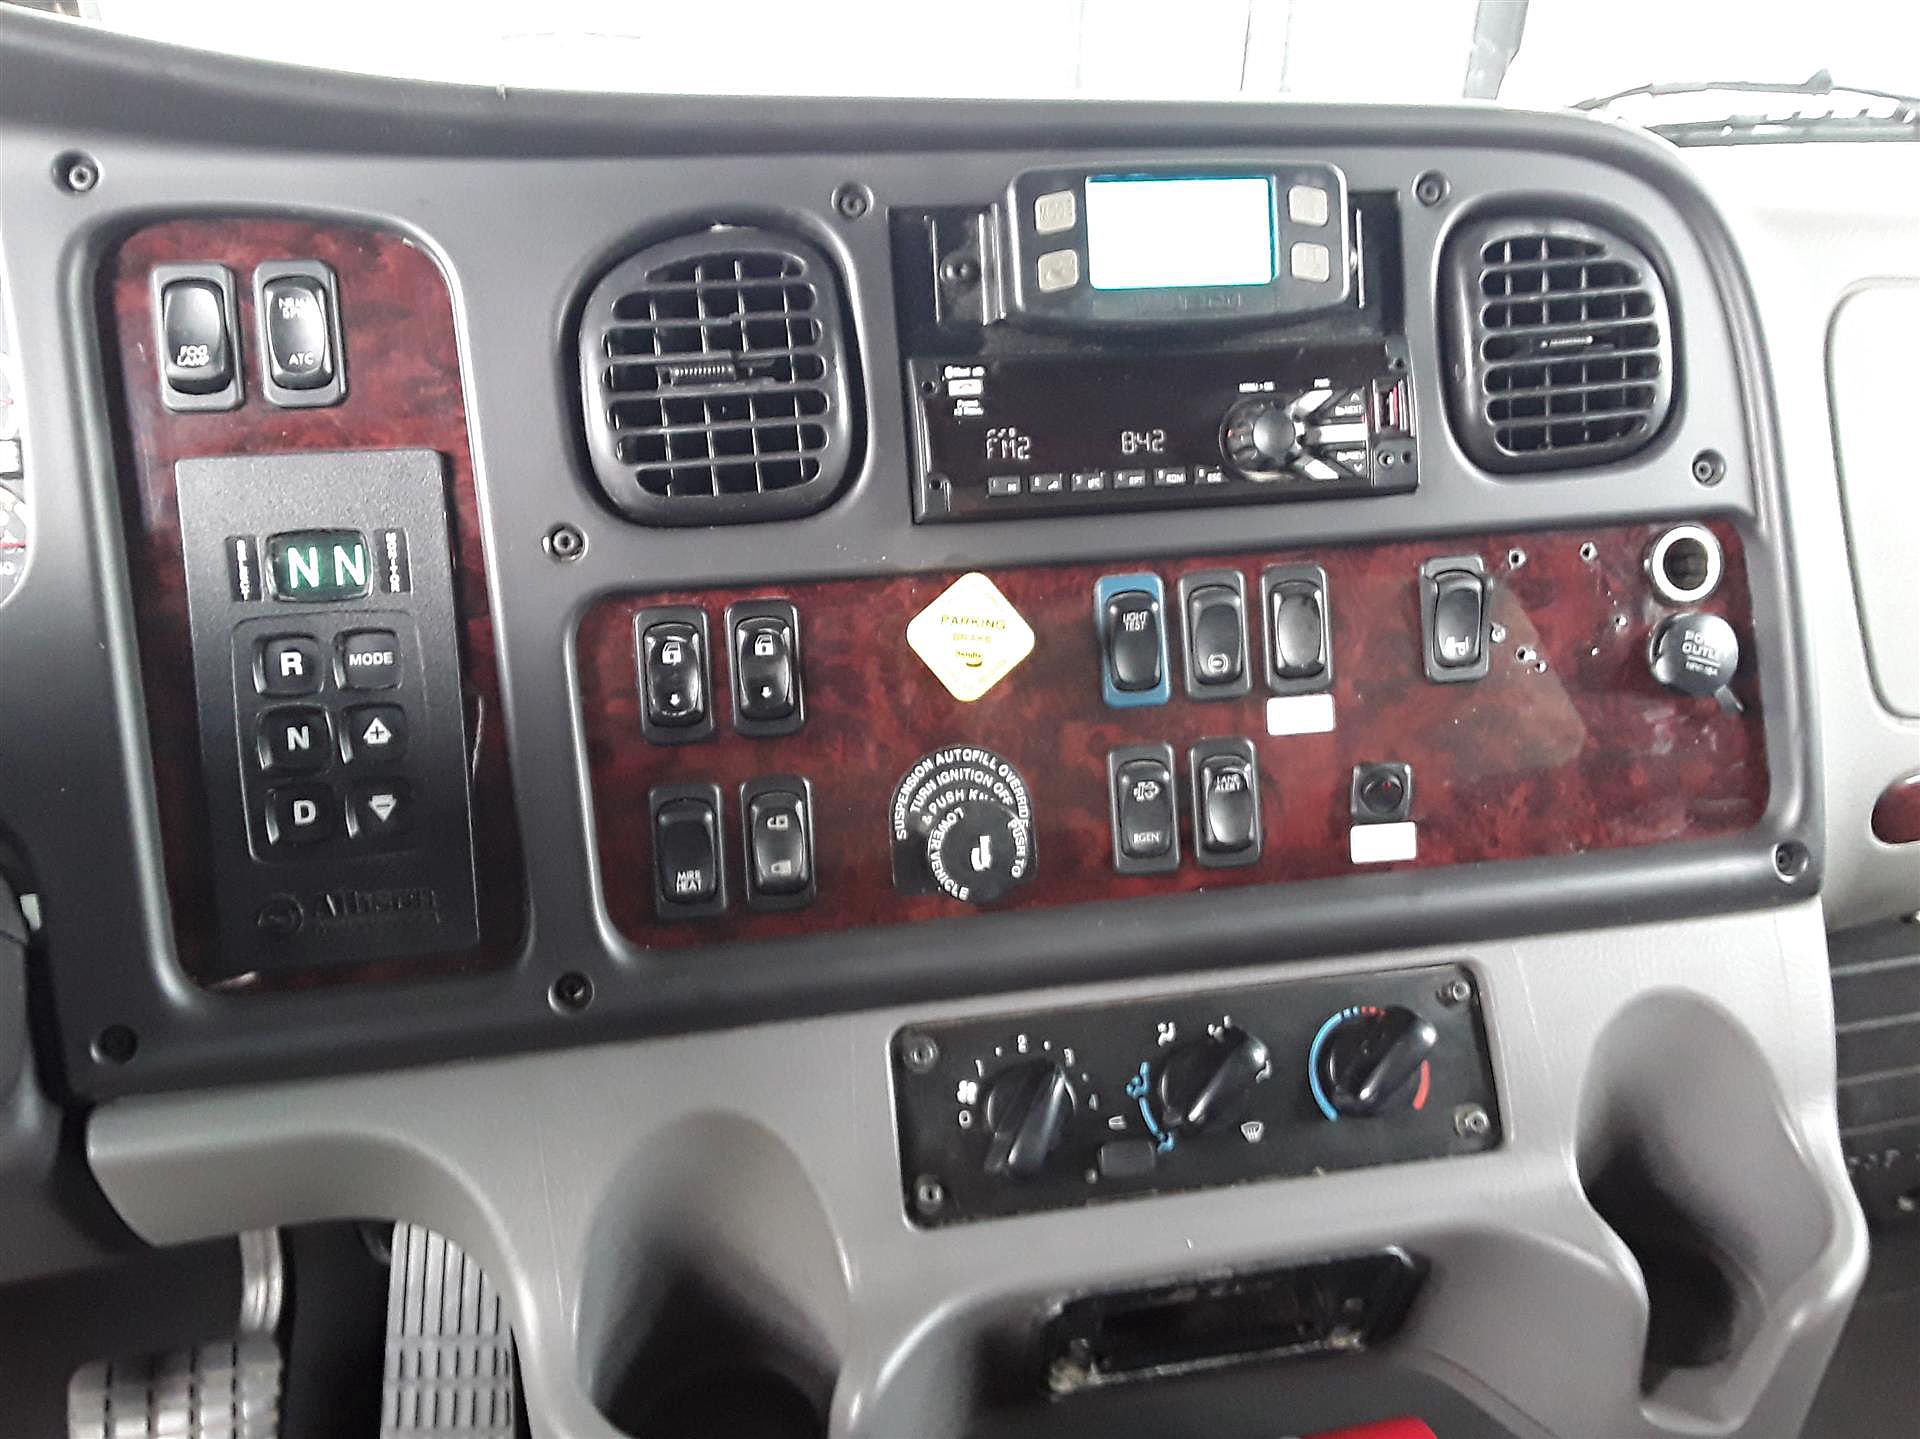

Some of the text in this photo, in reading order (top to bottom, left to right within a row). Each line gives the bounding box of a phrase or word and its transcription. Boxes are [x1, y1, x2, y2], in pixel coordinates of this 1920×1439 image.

[177, 354, 209, 368] LAMP
[180, 344, 208, 355] FOG
[288, 352, 314, 365] ATC
[986, 437, 1030, 459] FM2
[287, 544, 366, 588] N N
[384, 532, 401, 593] MONITOR
[1122, 611, 1148, 622] LIGHT
[1125, 621, 1145, 631] TEST
[280, 651, 303, 677] R
[349, 652, 393, 666] MODE
[287, 726, 310, 751] N
[894, 748, 1029, 841] SUSPENSION AUTOFILL OVERRIDE
[909, 767, 1014, 813] TURN IGNITION OFF
[293, 800, 317, 825] D
[921, 814, 933, 827] &
[928, 788, 965, 816] PUSH
[930, 806, 970, 901] LOWER VEHICLE
[1007, 818, 1026, 879] PUSH TO
[1017, 1034, 1028, 1053] 2
